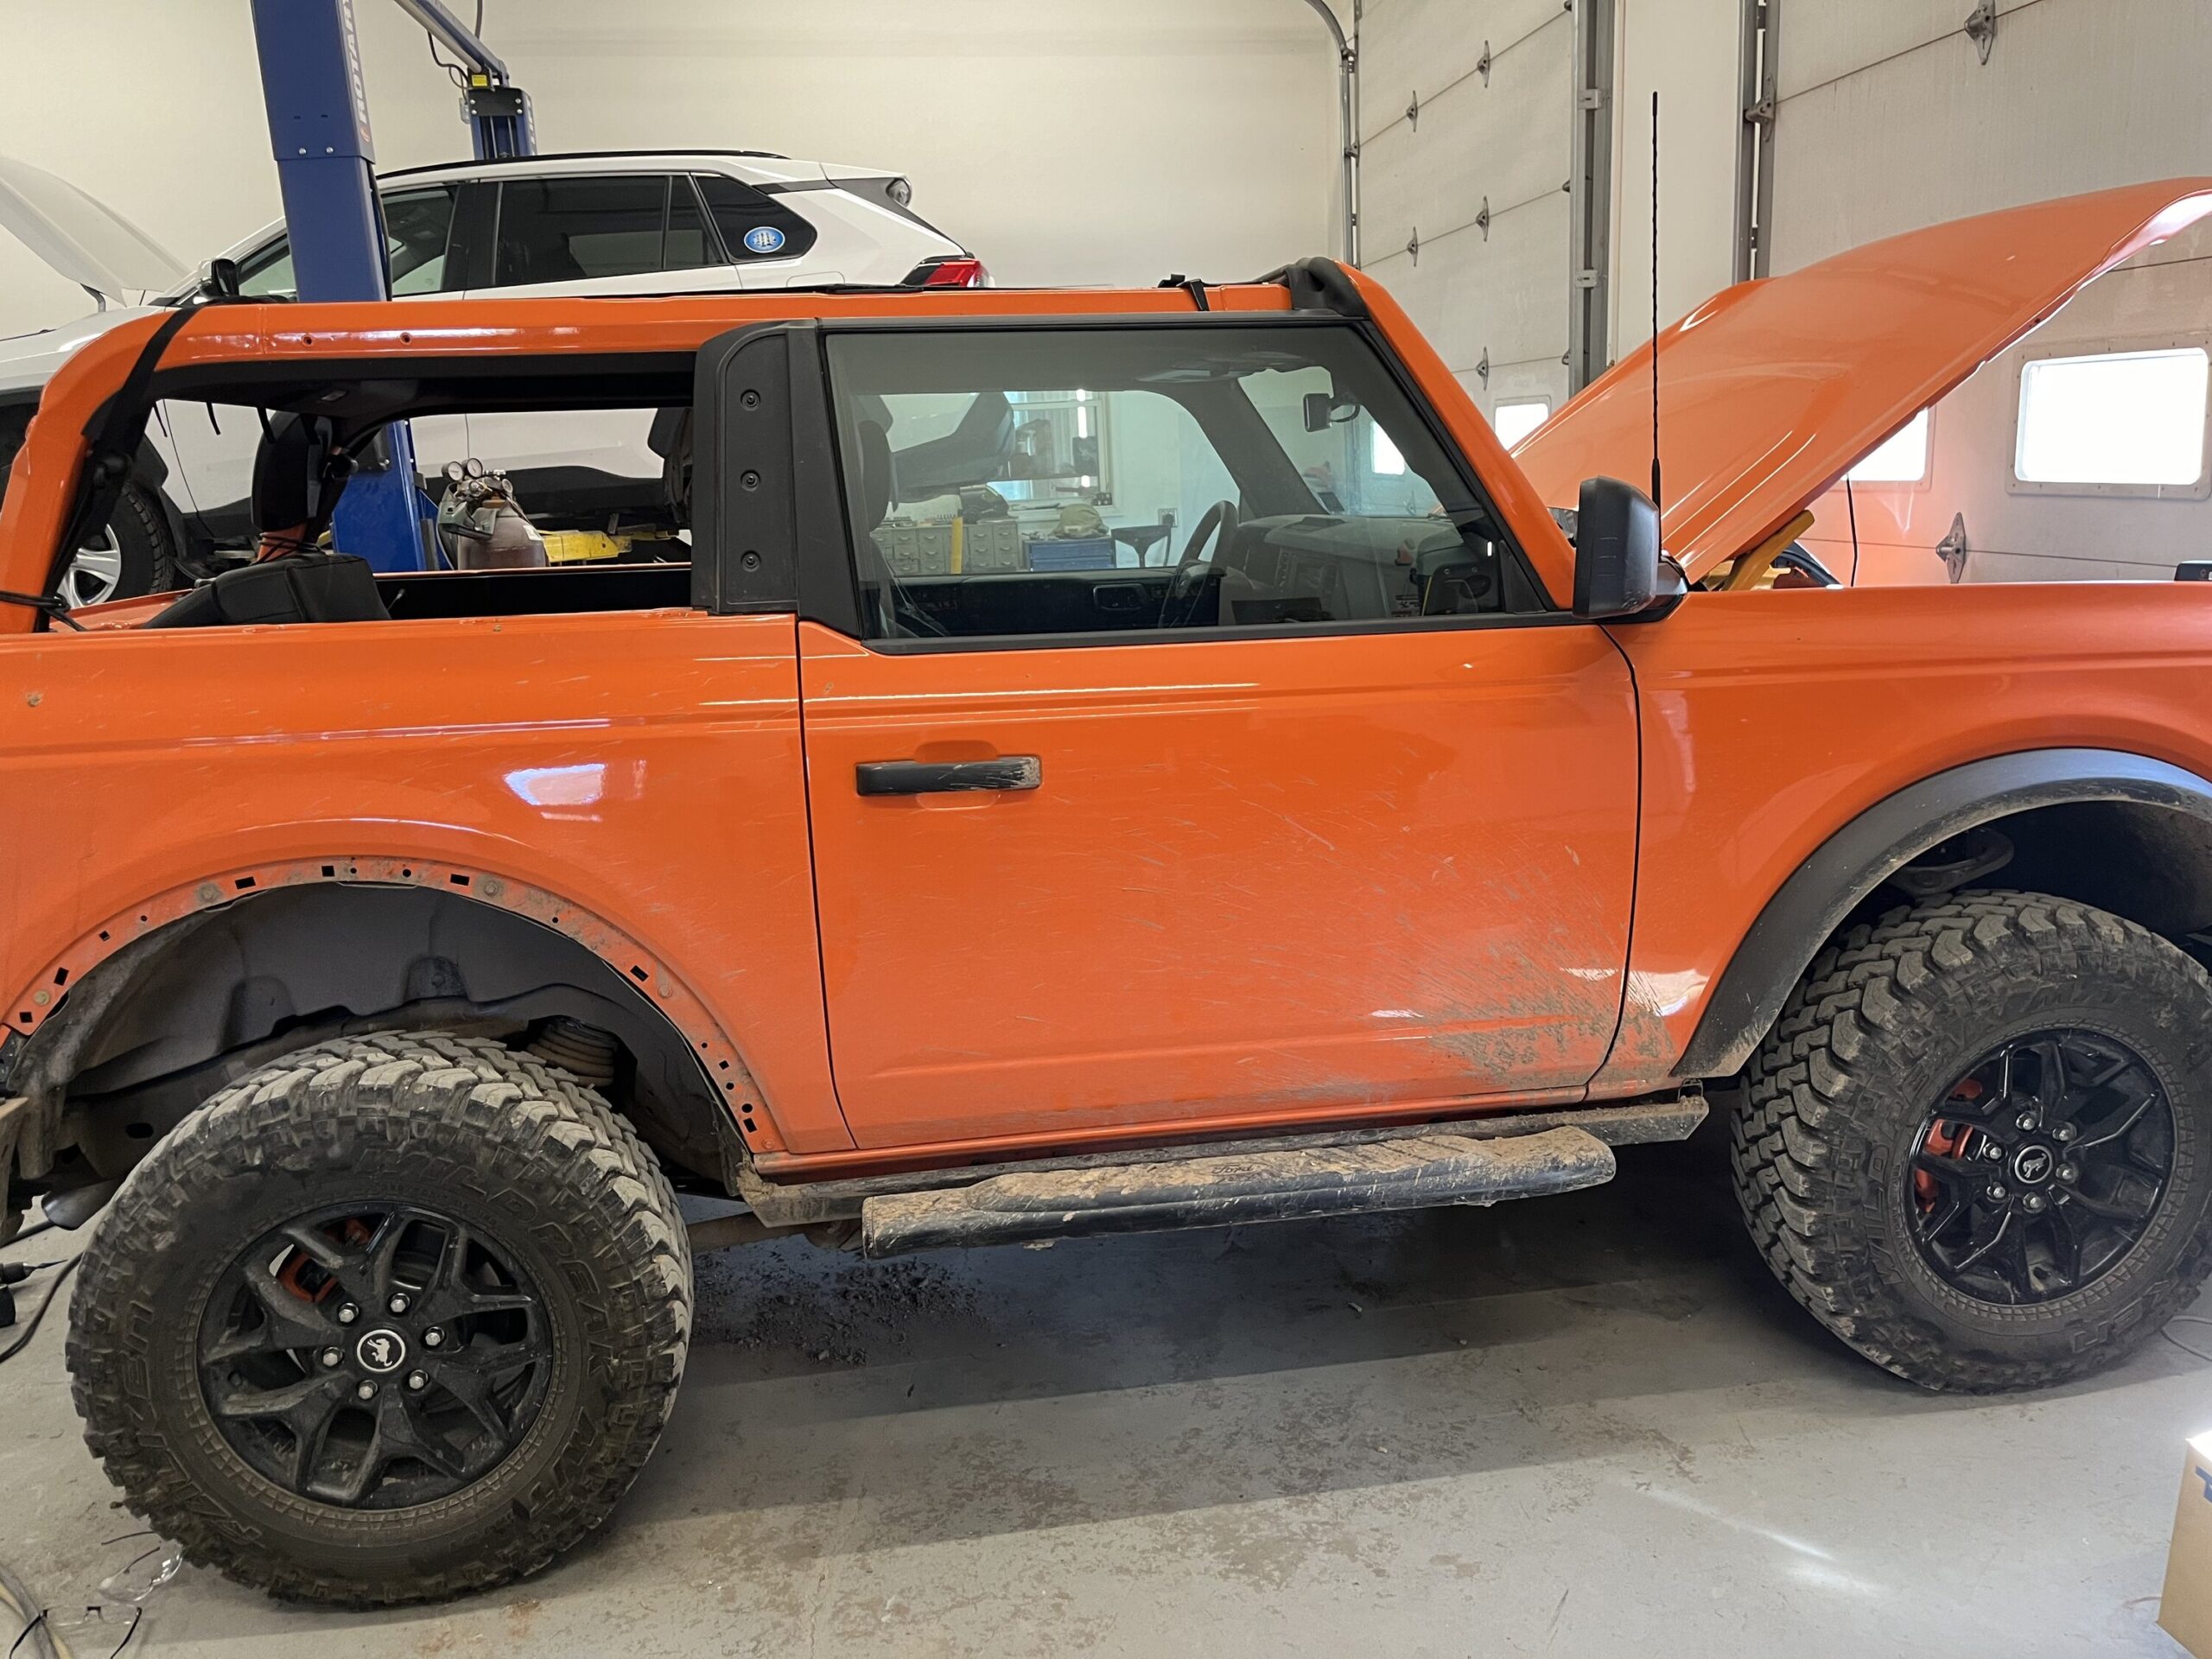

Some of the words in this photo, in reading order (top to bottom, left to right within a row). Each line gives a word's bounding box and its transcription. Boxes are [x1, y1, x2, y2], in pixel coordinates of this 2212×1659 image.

[342, 0, 367, 124] ROTAR
[1211, 1163, 1254, 1175] Ford
[353, 1147, 614, 1386] WILDPEAK
